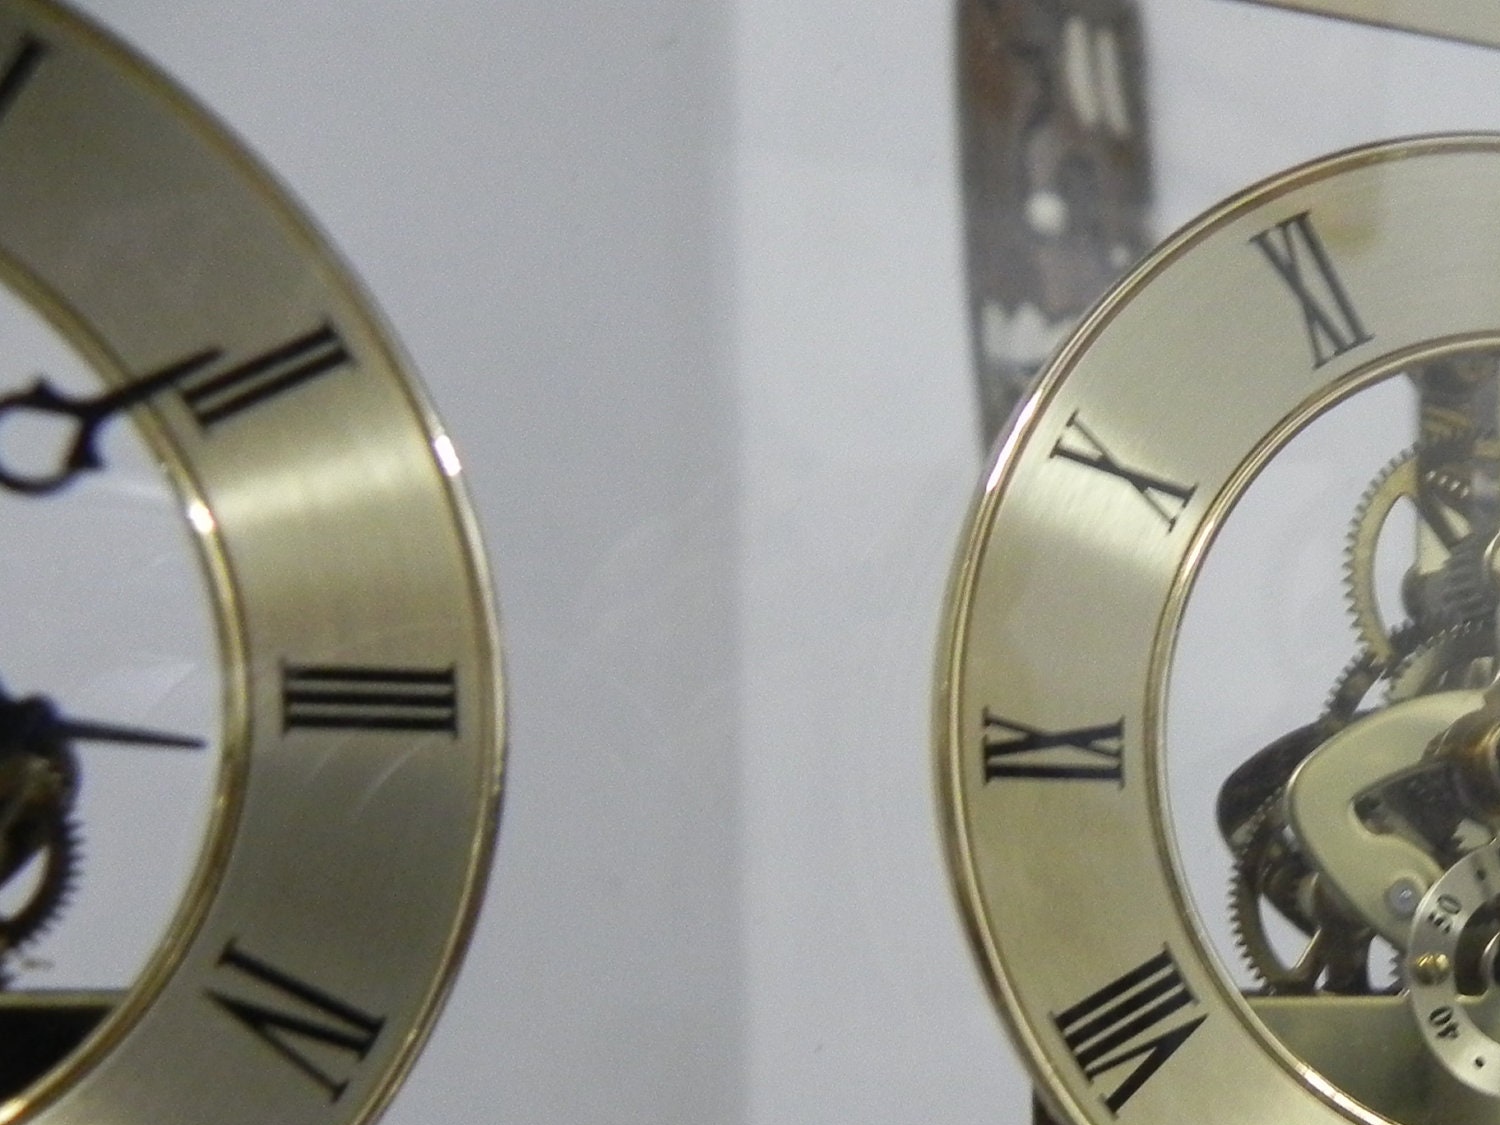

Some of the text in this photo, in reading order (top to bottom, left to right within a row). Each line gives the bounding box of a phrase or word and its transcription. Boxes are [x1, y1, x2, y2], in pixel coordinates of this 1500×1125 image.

[1250, 211, 1374, 370] XI
[175, 312, 358, 437] II
[1050, 411, 1196, 534] X
[280, 657, 457, 738] III
[982, 707, 1125, 789] IX
[1428, 894, 1462, 934] 50
[205, 938, 386, 1101] IV
[1048, 941, 1209, 1120] VIII
